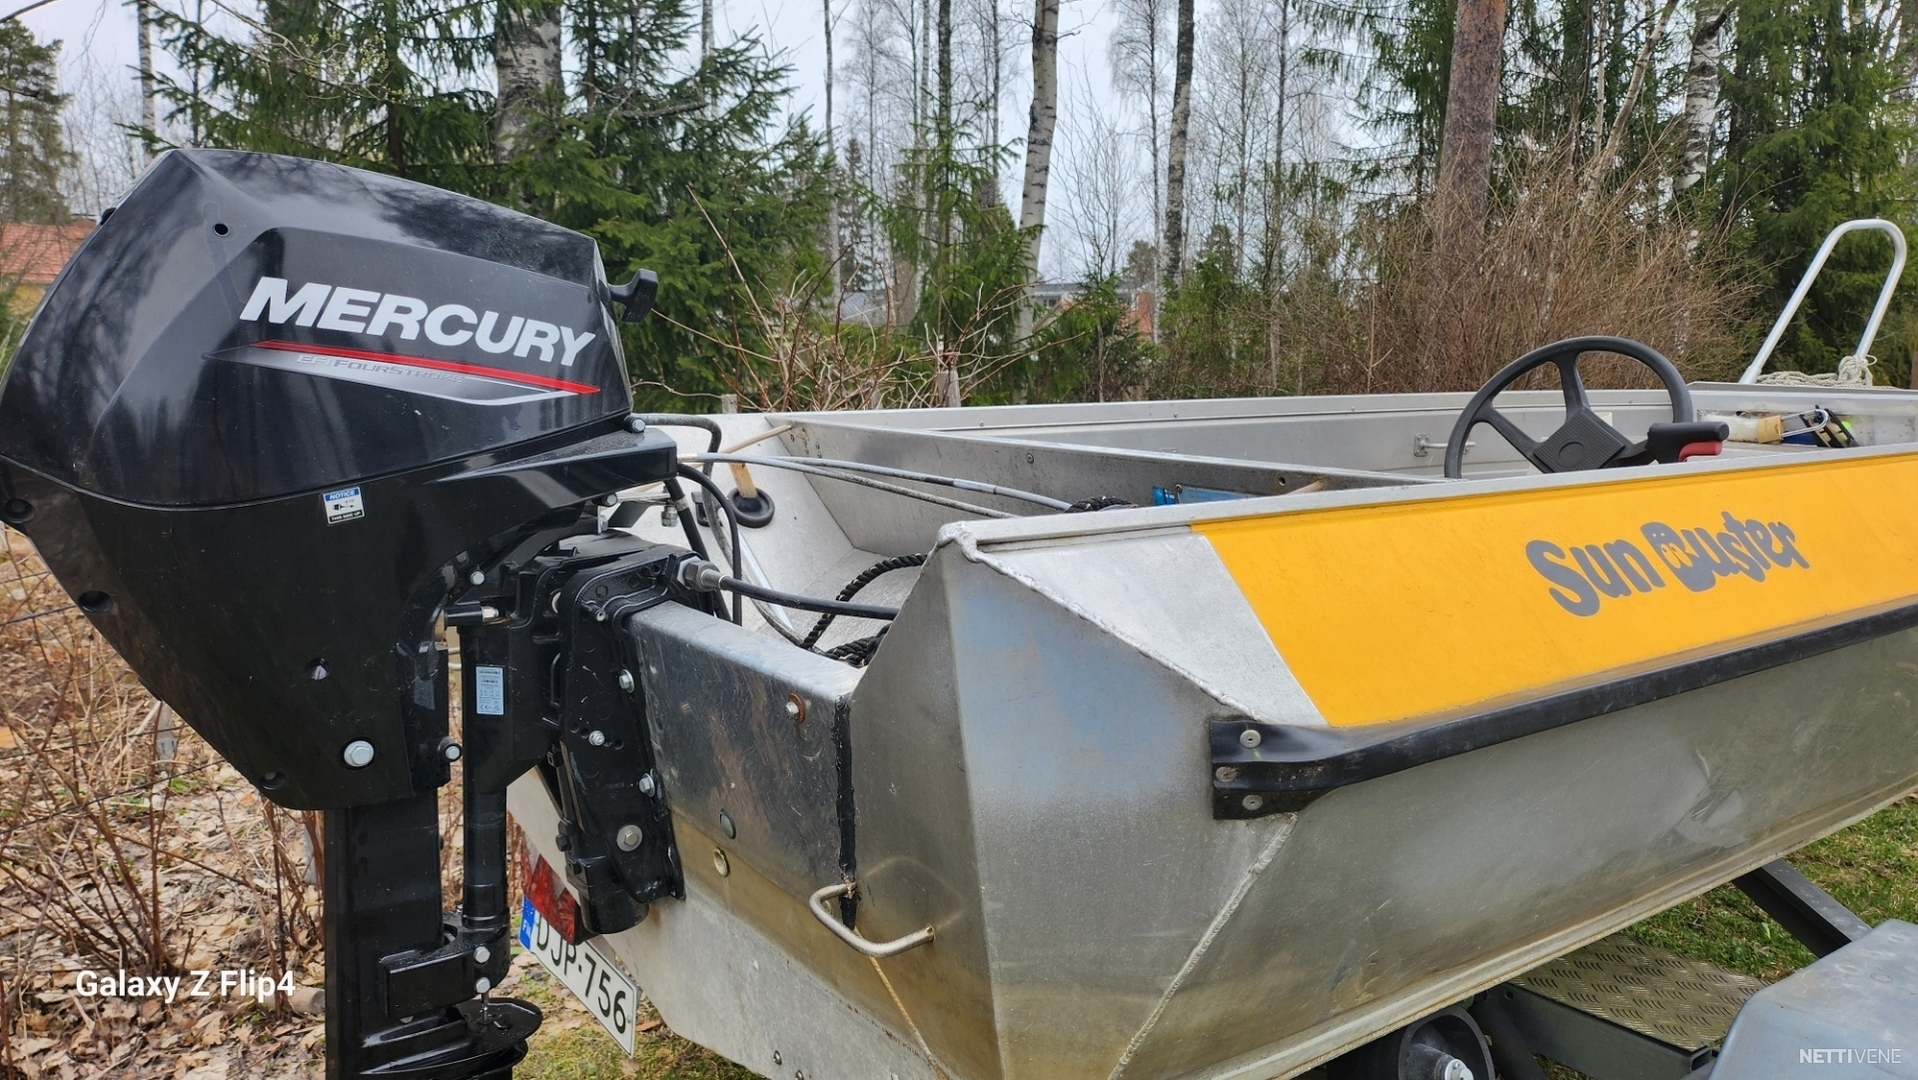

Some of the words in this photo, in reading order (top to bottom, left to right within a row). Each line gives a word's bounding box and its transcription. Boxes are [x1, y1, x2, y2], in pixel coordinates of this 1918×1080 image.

[239, 276, 596, 367] MERCURY
[296, 354, 332, 370] EFI
[329, 490, 355, 500] NOTICE
[1525, 539, 1666, 617] Sun
[1640, 511, 1811, 592] Buster
[536, 912, 626, 1034] DJP-756
